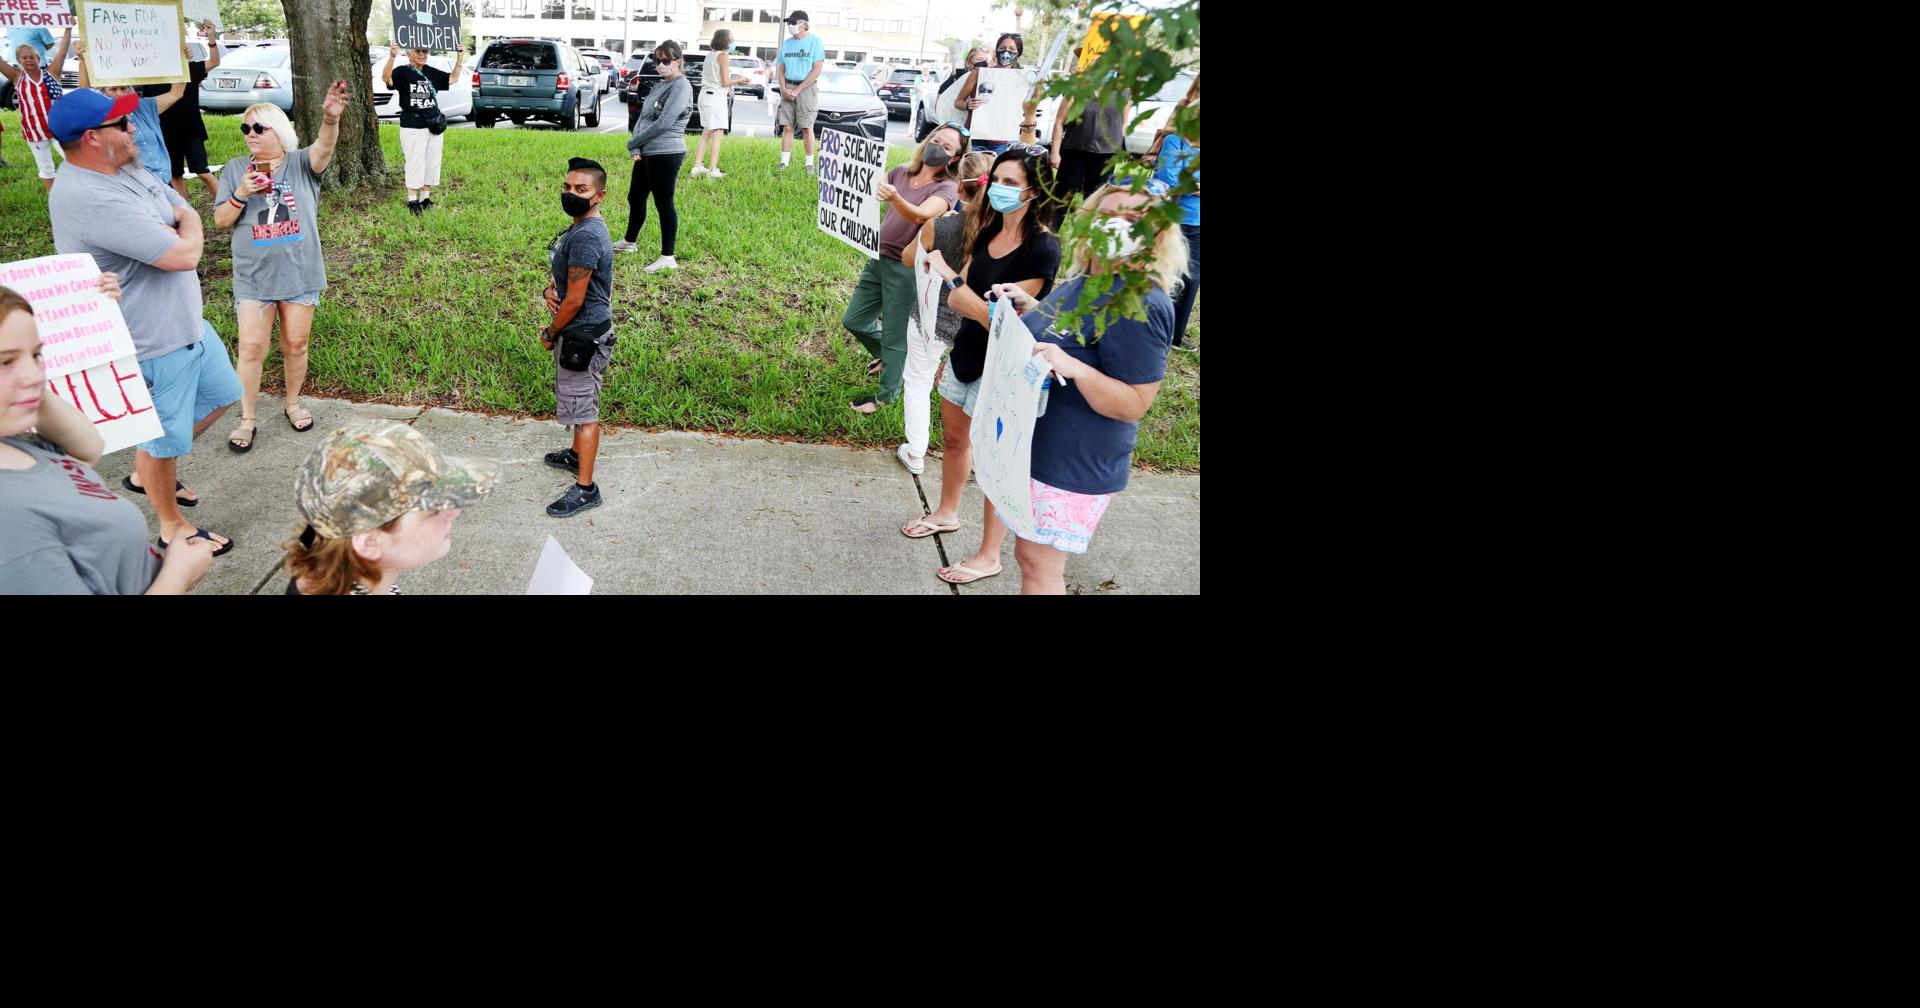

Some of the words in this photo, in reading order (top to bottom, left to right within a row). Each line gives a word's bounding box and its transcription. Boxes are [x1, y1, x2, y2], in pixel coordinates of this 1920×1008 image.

[20, 13, 54, 26] FOR
[95, 39, 113, 52] NO
[397, 25, 461, 50] CHILDREN
[99, 55, 119, 70] NO
[821, 129, 885, 168] PRO-SCIENCE
[818, 156, 874, 195] PRO-MASK
[818, 180, 863, 217] PROTECT
[820, 207, 837, 232] OUR
[840, 216, 879, 252] CHILDREN
[9, 268, 36, 282] BODY
[37, 263, 52, 276] MY
[55, 282, 69, 295] MY
[45, 306, 71, 322] TAKE
[71, 301, 98, 316] AWAY
